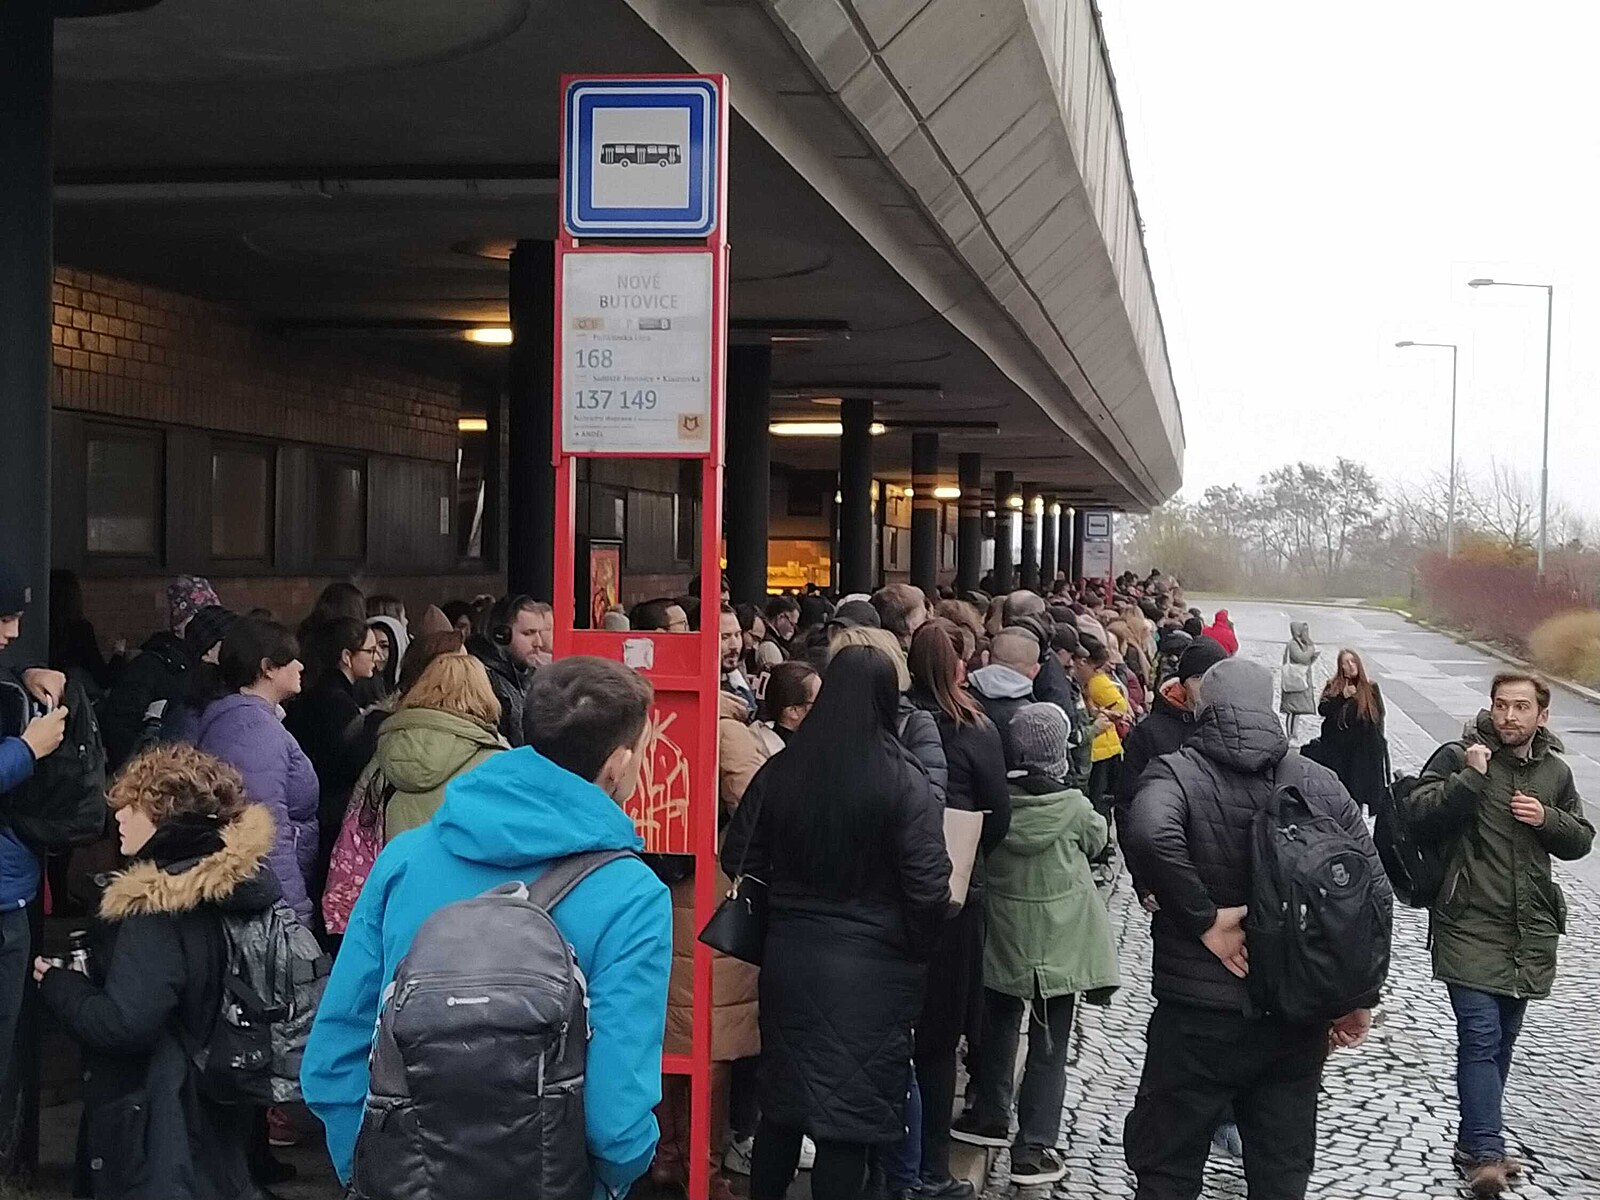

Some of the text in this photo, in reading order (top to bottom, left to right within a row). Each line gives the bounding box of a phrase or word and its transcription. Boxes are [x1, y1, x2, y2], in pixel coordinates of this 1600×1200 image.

[617, 273, 661, 290] NOVÉ
[600, 294, 679, 309] BUTOVICE
[575, 349, 613, 368] 168
[575, 390, 657, 409] 137 149
